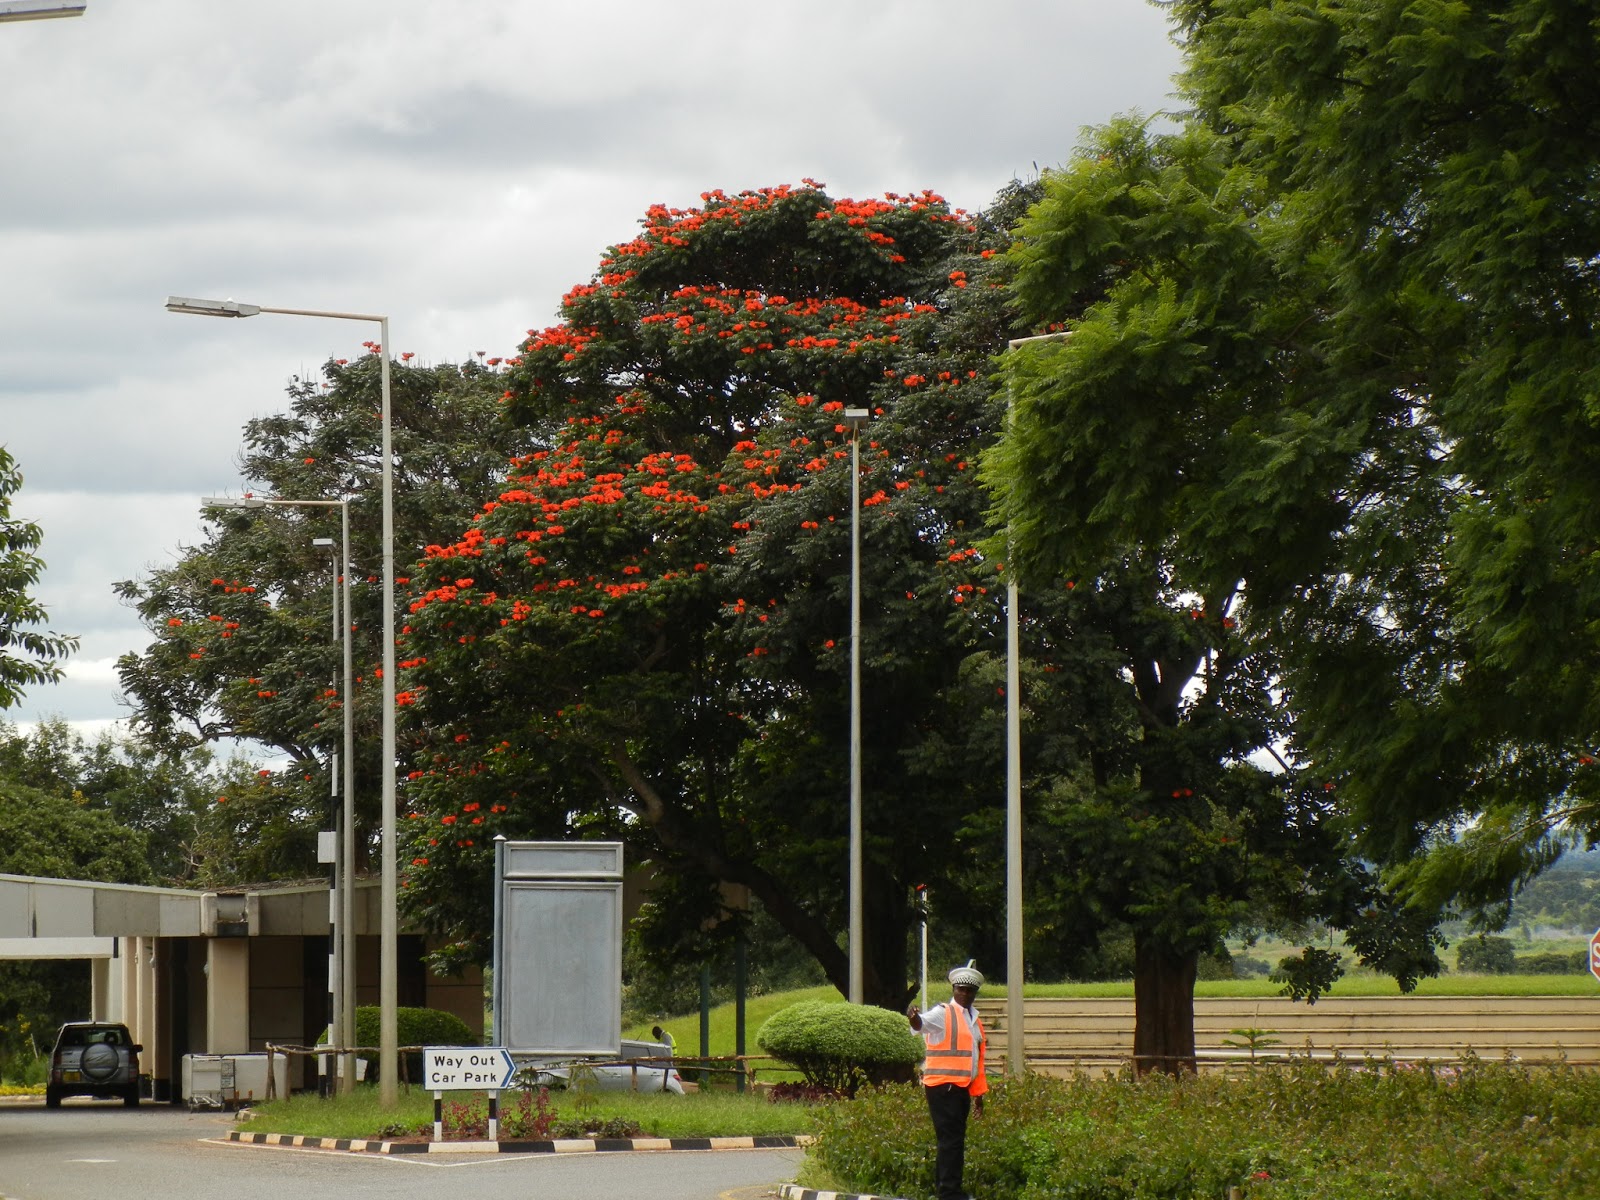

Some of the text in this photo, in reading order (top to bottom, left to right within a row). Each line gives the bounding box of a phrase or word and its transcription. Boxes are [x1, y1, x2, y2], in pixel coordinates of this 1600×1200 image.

[434, 1055, 495, 1068] Way Out
[432, 1072, 497, 1083] Car Park
